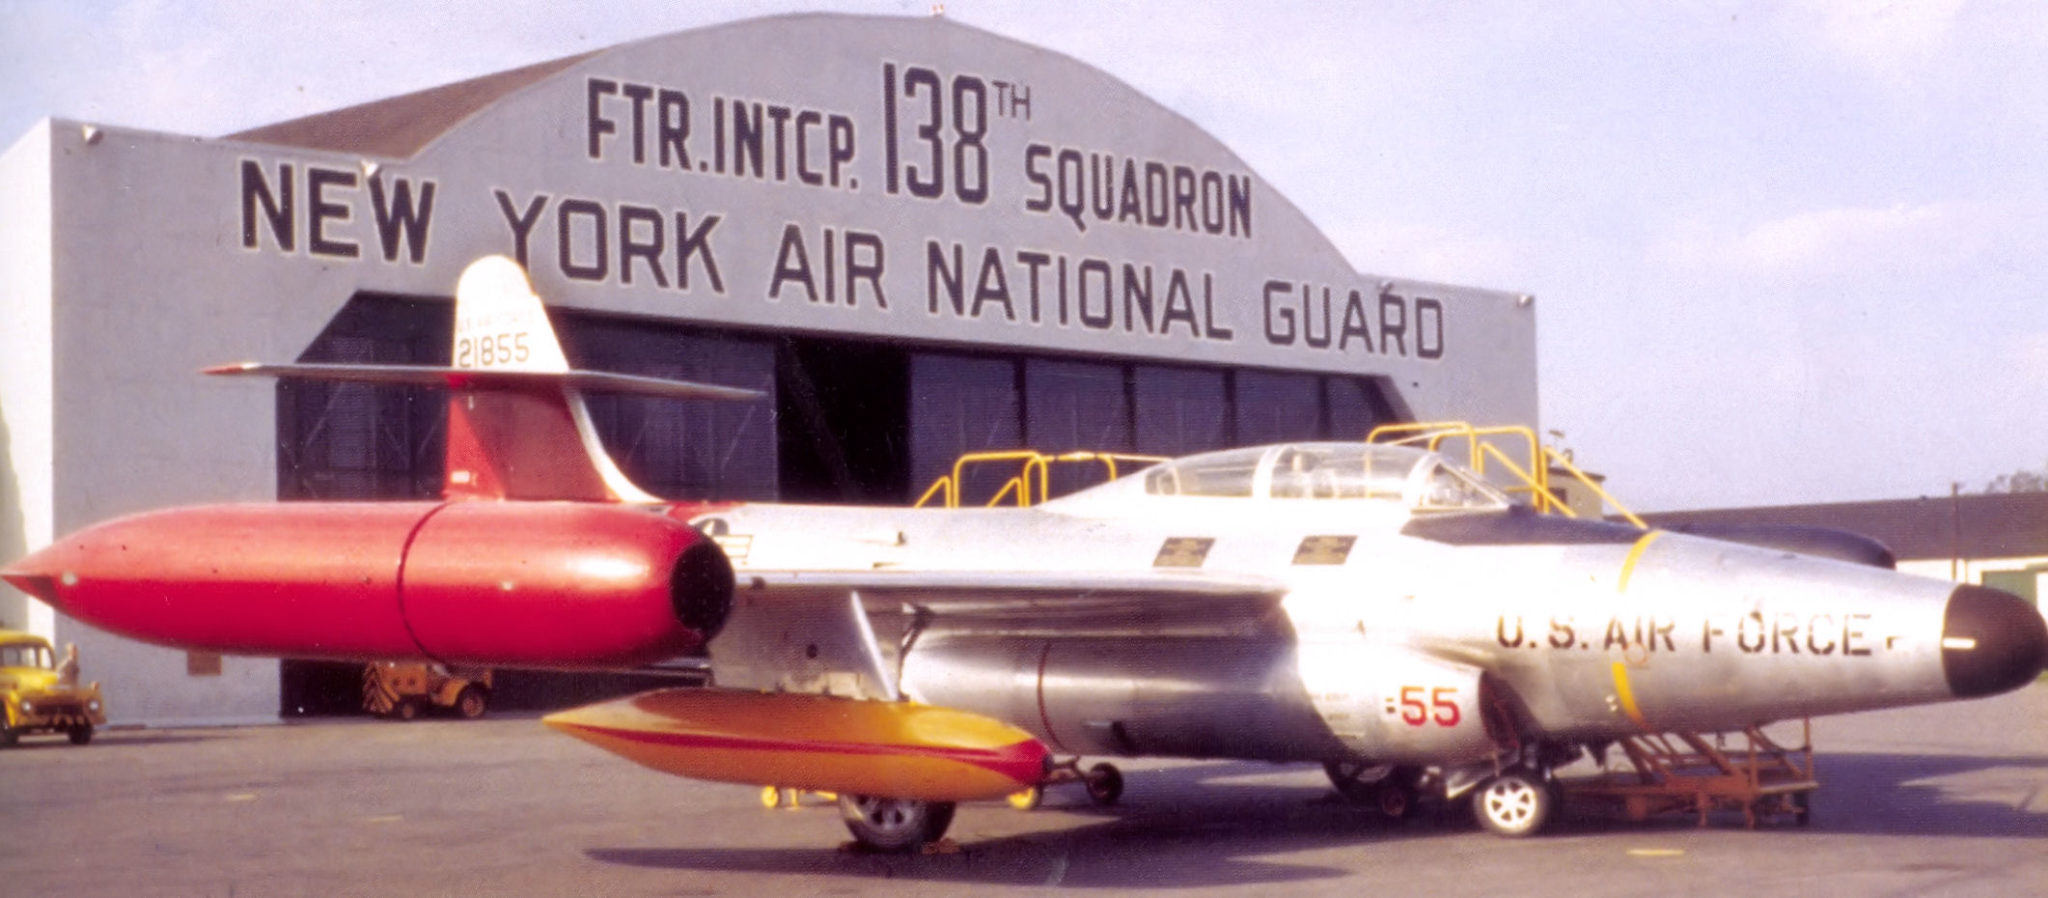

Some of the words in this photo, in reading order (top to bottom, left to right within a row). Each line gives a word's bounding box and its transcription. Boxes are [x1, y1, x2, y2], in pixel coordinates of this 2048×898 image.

[1025, 143, 1252, 239] SQUADRON
[241, 159, 436, 265] NEW
[494, 189, 725, 294] YORK
[768, 223, 888, 309] AIR
[927, 240, 1234, 341] NATIONAL
[1262, 279, 1444, 360] GUARD
[458, 331, 531, 368] 21855
[1496, 613, 1589, 650] U.S.
[1603, 614, 1677, 653] AIR
[1702, 611, 1873, 656] FORCE
